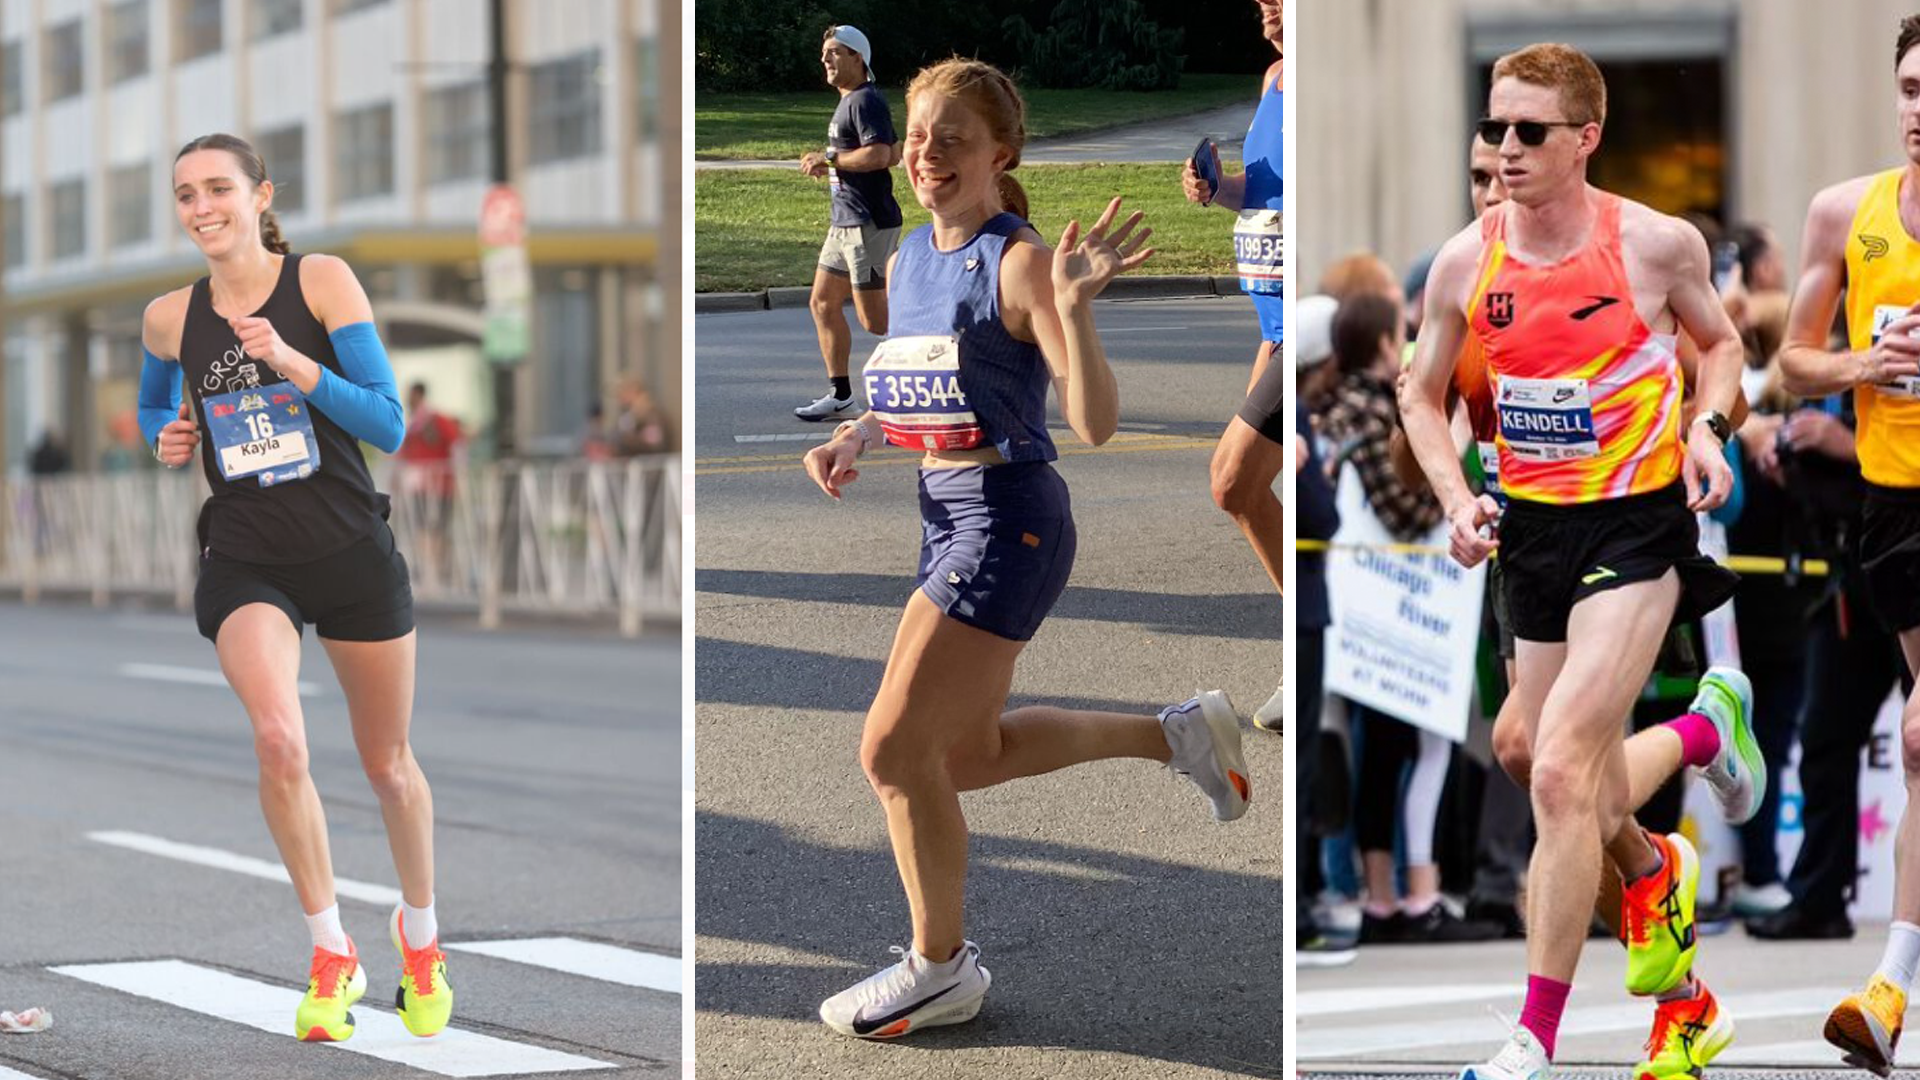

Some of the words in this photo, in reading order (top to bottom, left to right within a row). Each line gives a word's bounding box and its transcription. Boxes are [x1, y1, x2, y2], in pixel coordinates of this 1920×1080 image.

[864, 375, 879, 407] F
[885, 375, 966, 408] 35544
[244, 412, 274, 441] 16
[1501, 409, 1590, 433] KENDELL
[240, 438, 280, 456] Kayla
[1354, 544, 1431, 594] Chicago
[1399, 597, 1450, 635] River
